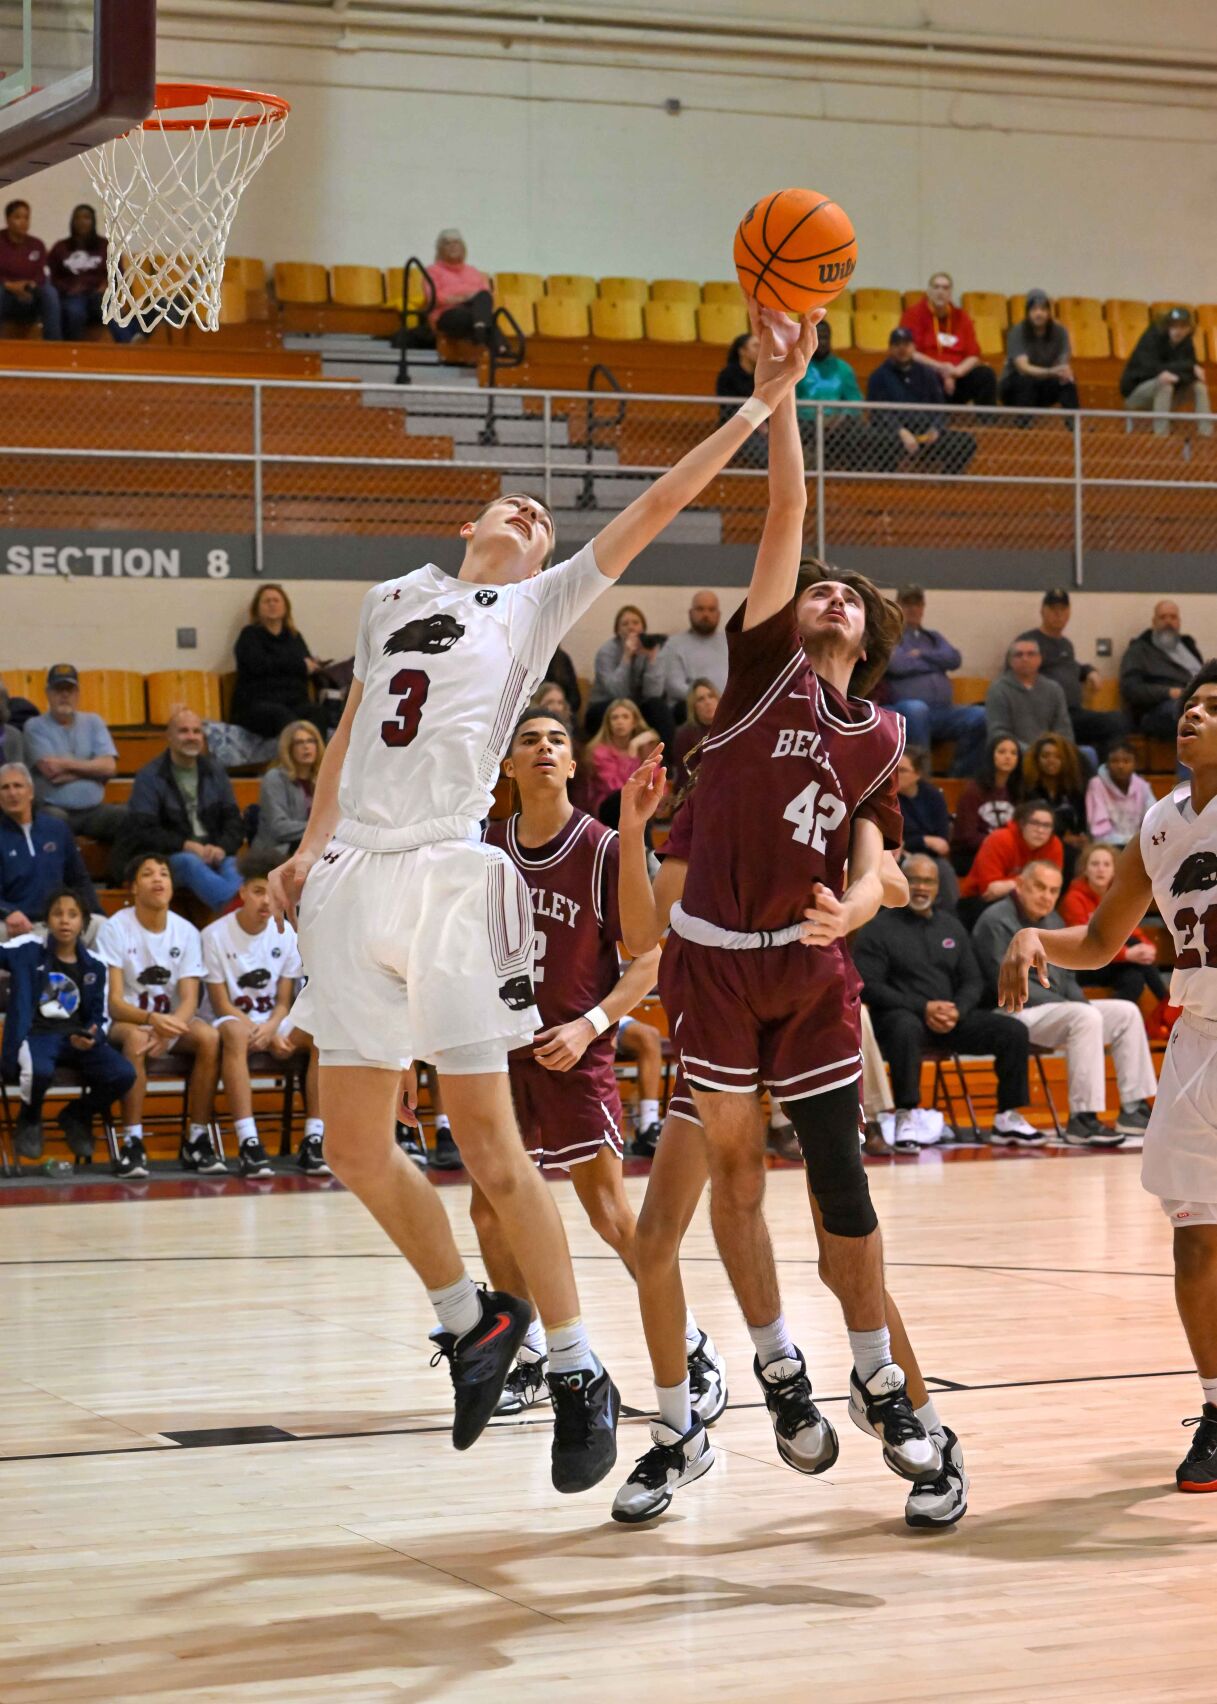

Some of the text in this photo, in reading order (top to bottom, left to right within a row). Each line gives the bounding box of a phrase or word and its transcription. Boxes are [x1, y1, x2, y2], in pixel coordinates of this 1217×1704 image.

[7, 546, 230, 578] SECTION 8
[381, 668, 431, 747] 3
[783, 780, 847, 856] 42
